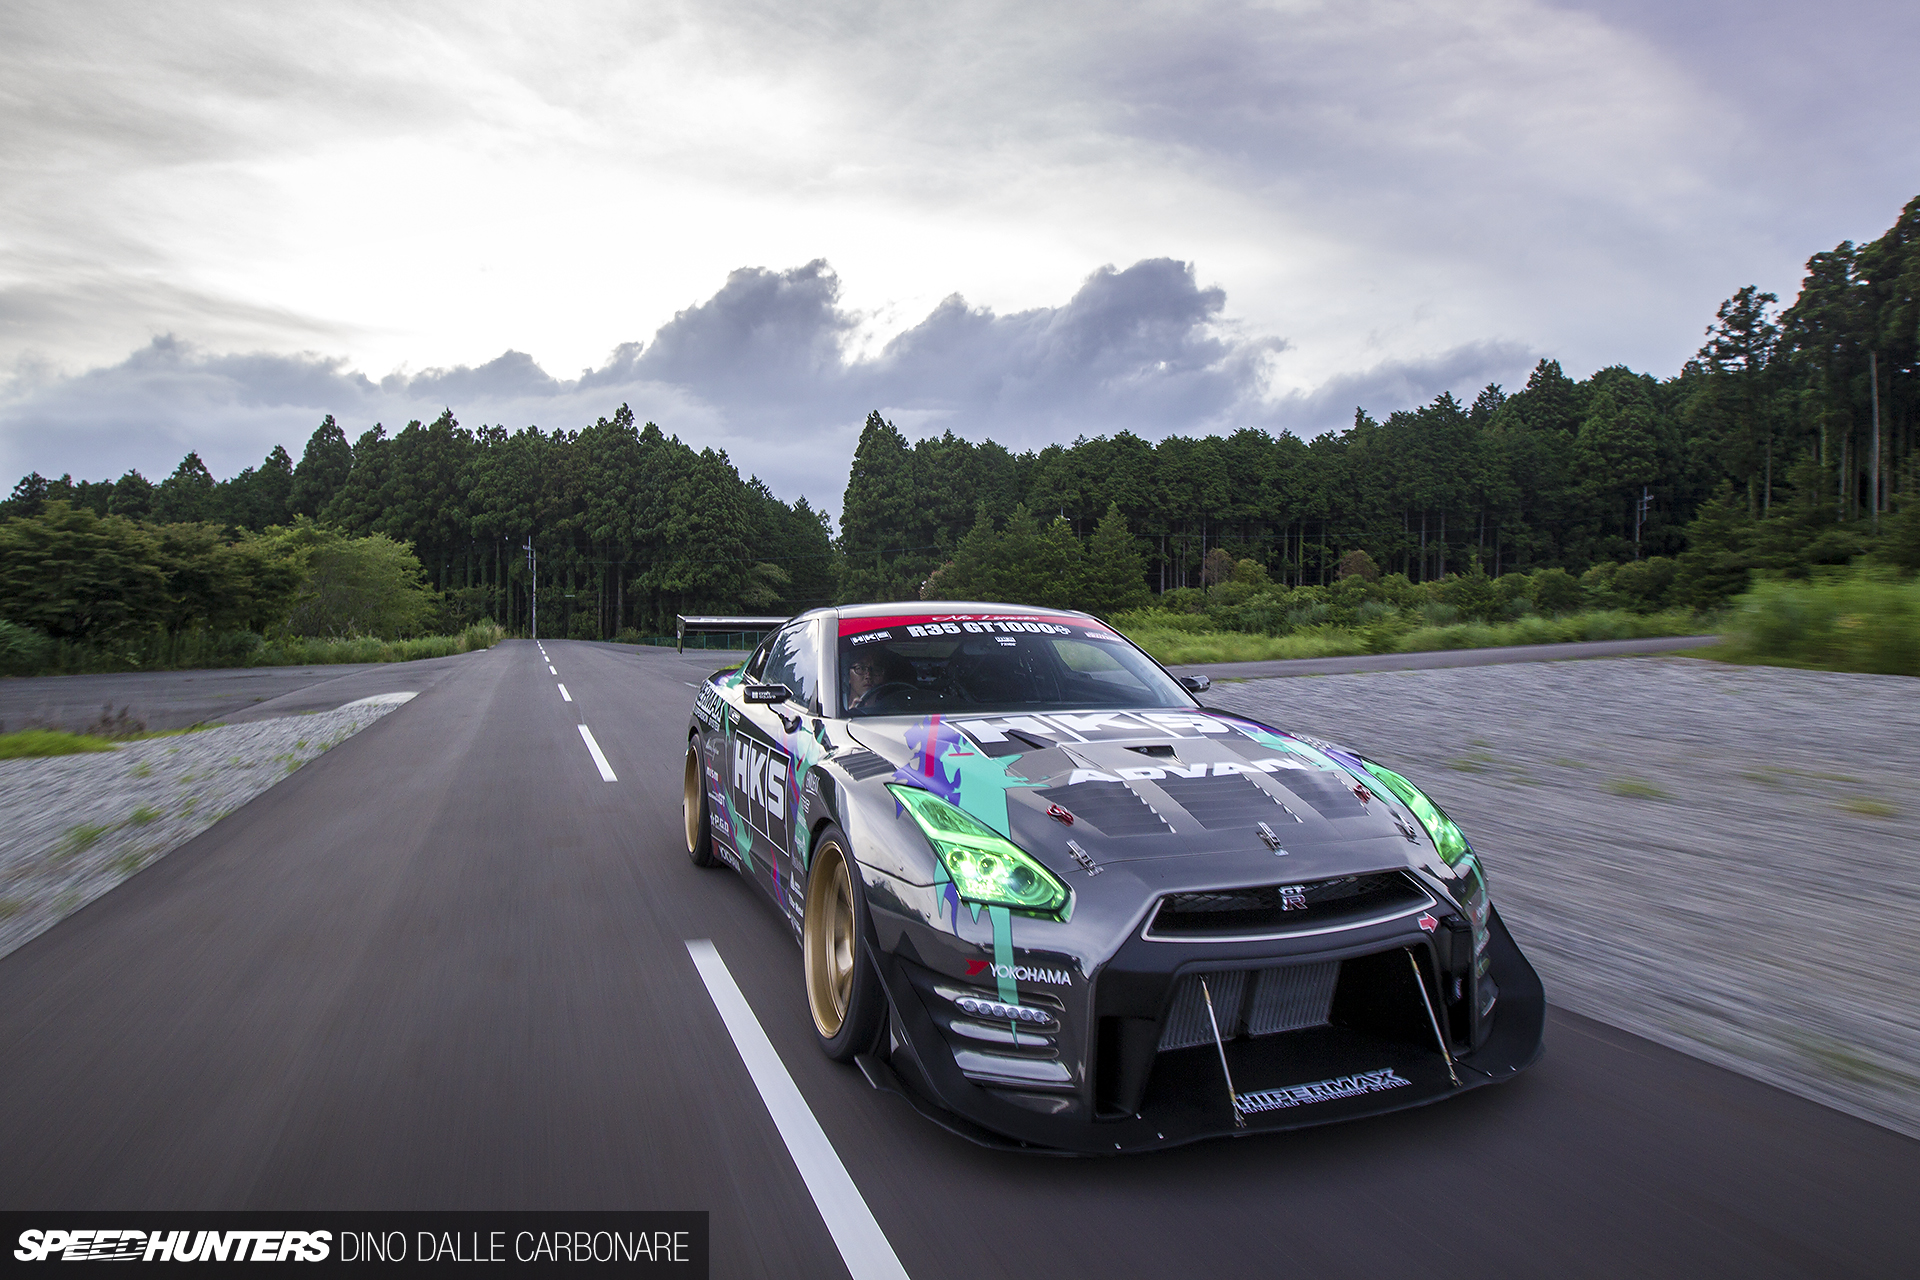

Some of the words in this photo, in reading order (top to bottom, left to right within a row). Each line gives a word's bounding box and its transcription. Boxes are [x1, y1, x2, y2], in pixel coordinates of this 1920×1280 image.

[906, 622, 961, 638] R35
[955, 713, 1230, 743] HKS
[734, 739, 787, 820] HKS
[1068, 758, 1308, 785] ADVAN
[989, 961, 1073, 987] YOKOHAMA
